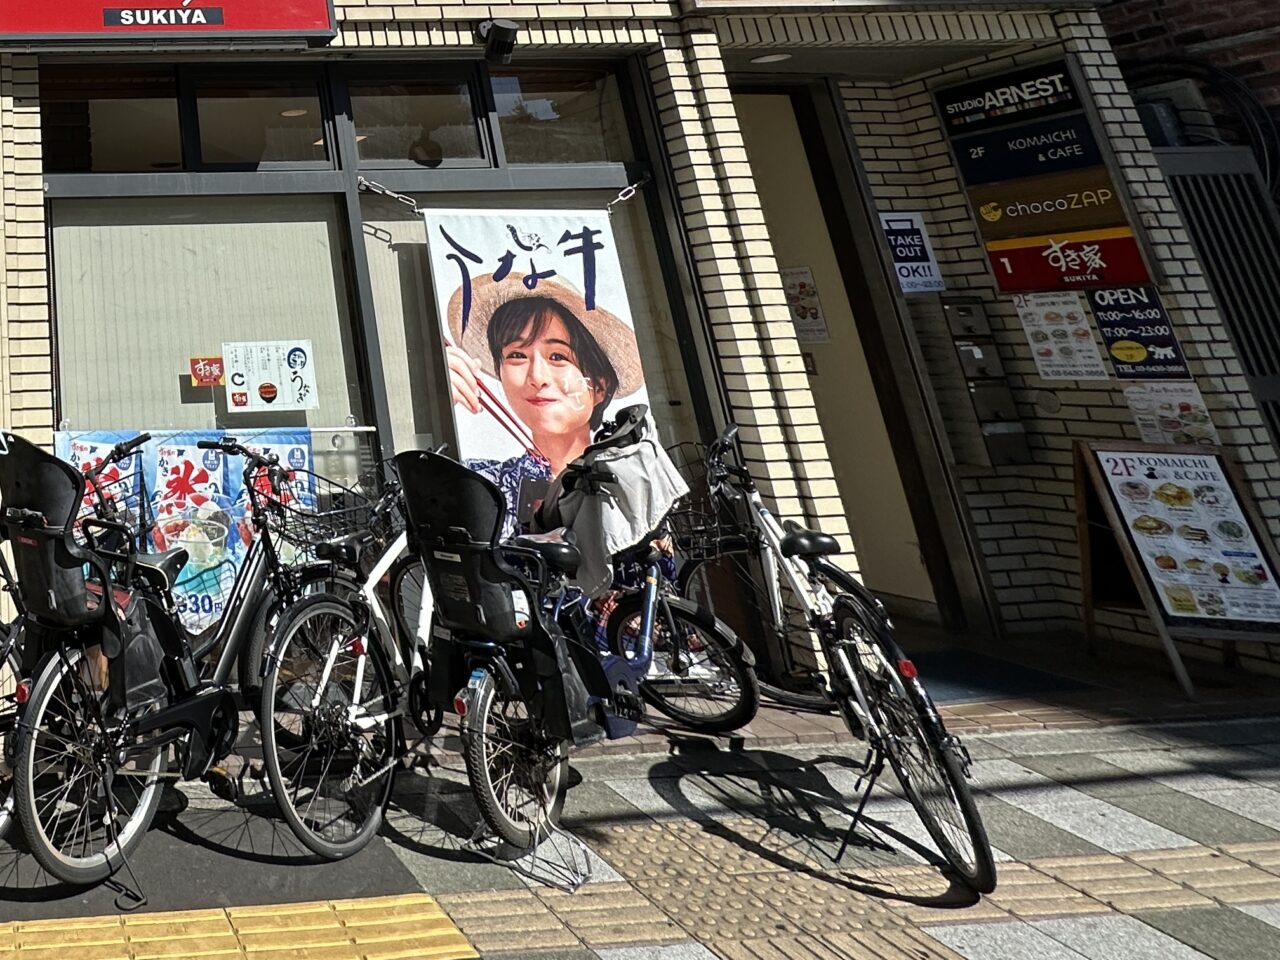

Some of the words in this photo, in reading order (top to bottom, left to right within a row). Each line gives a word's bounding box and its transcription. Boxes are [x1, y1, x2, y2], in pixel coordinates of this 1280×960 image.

[120, 8, 209, 26] SUKIYA
[946, 97, 985, 114] STUDIO
[984, 73, 1066, 110] ARNEST
[1007, 128, 1077, 151] KOMAICHI
[970, 146, 986, 159] 2F
[1047, 144, 1084, 160] CAFE
[1006, 189, 1112, 217] chocoZAP
[887, 235, 923, 246] TAKE
[896, 246, 922, 257] OUT
[1000, 257, 1013, 274] 1
[1042, 239, 1107, 274] すき家
[898, 264, 934, 278] OK!!
[1063, 274, 1100, 282] SUKIYA
[1094, 287, 1150, 306] OPEN
[194, 359, 222, 378] すき家
[1105, 457, 1136, 477] 2F
[1137, 456, 1210, 470] KOMAICHI
